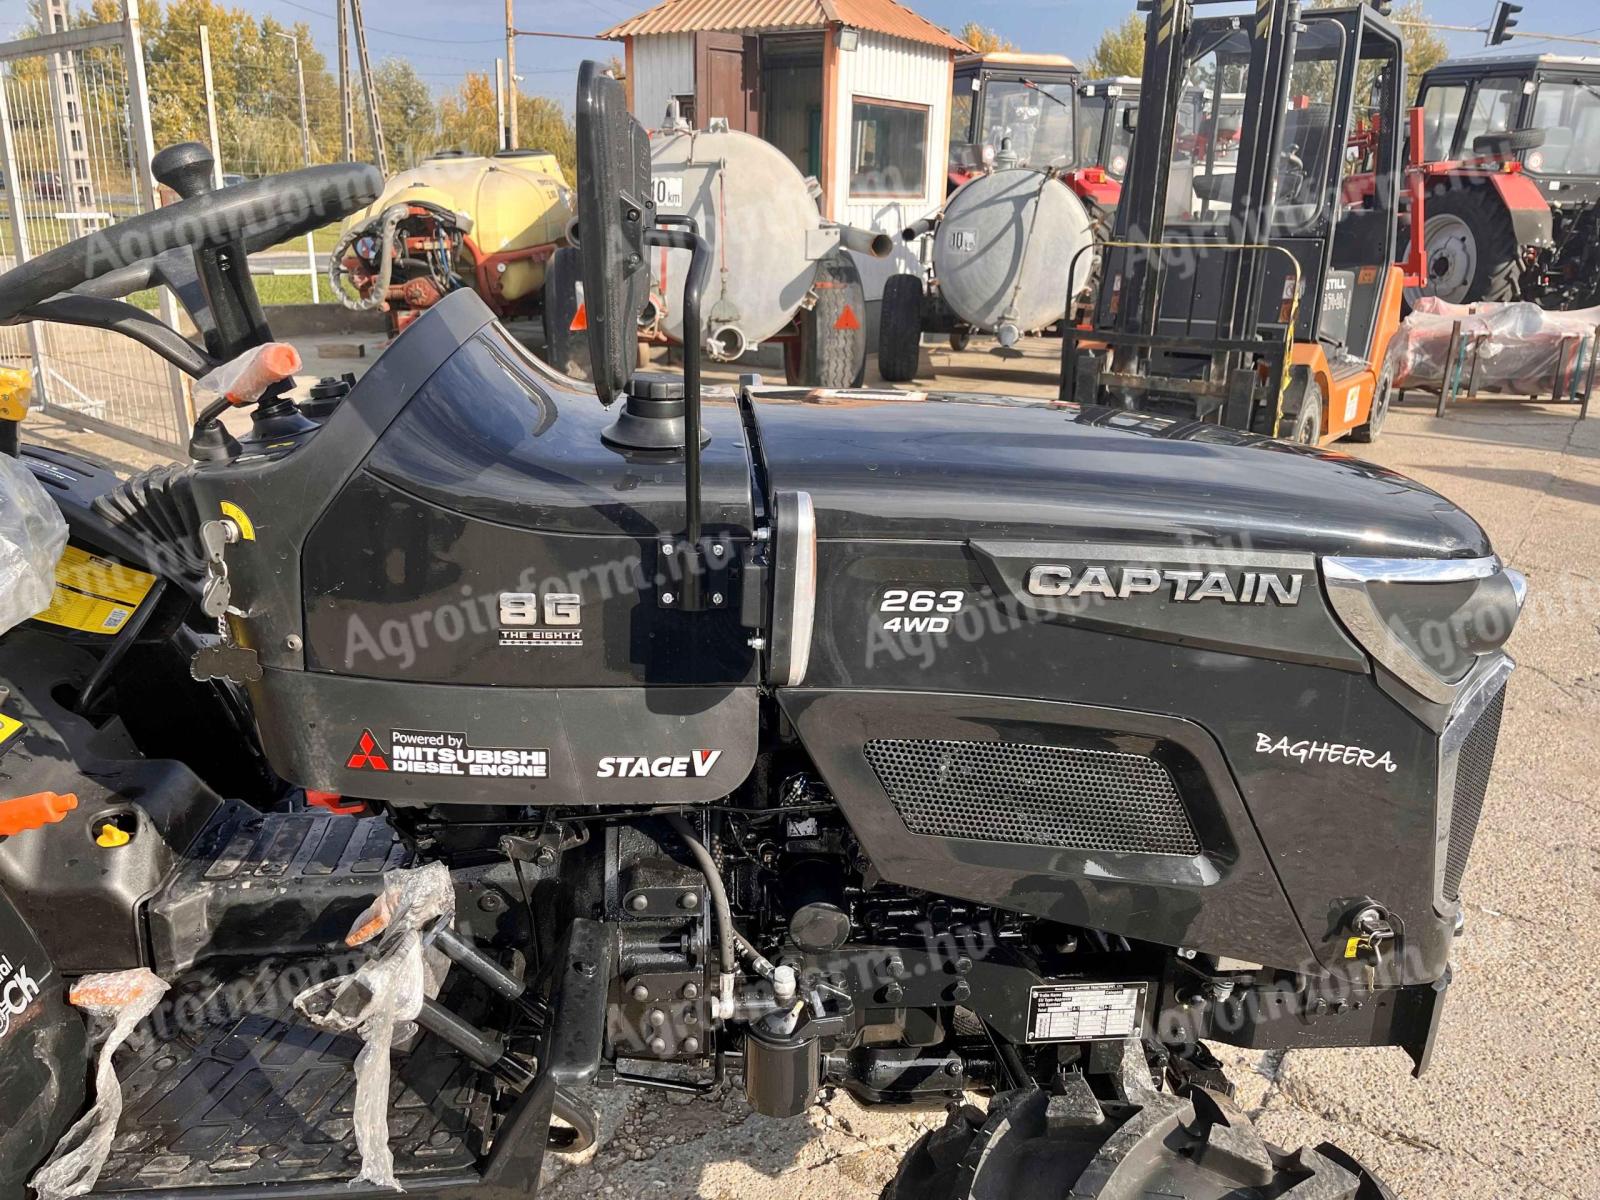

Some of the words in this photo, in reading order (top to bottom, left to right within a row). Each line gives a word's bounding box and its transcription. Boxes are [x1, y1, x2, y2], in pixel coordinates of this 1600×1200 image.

[1028, 564, 1303, 604] CAPTAIN
[499, 592, 580, 625] 8G
[880, 590, 964, 612] 263
[883, 617, 949, 632] 4WD
[502, 631, 527, 639] THE
[532, 631, 580, 639] EIGHTH
[393, 731, 444, 746] Powered
[448, 732, 463, 748] by
[393, 746, 546, 765] MITSUBISHI
[1255, 732, 1397, 772] BAGHEERA
[393, 760, 464, 775] DIESEL
[469, 764, 547, 777] ENGINE
